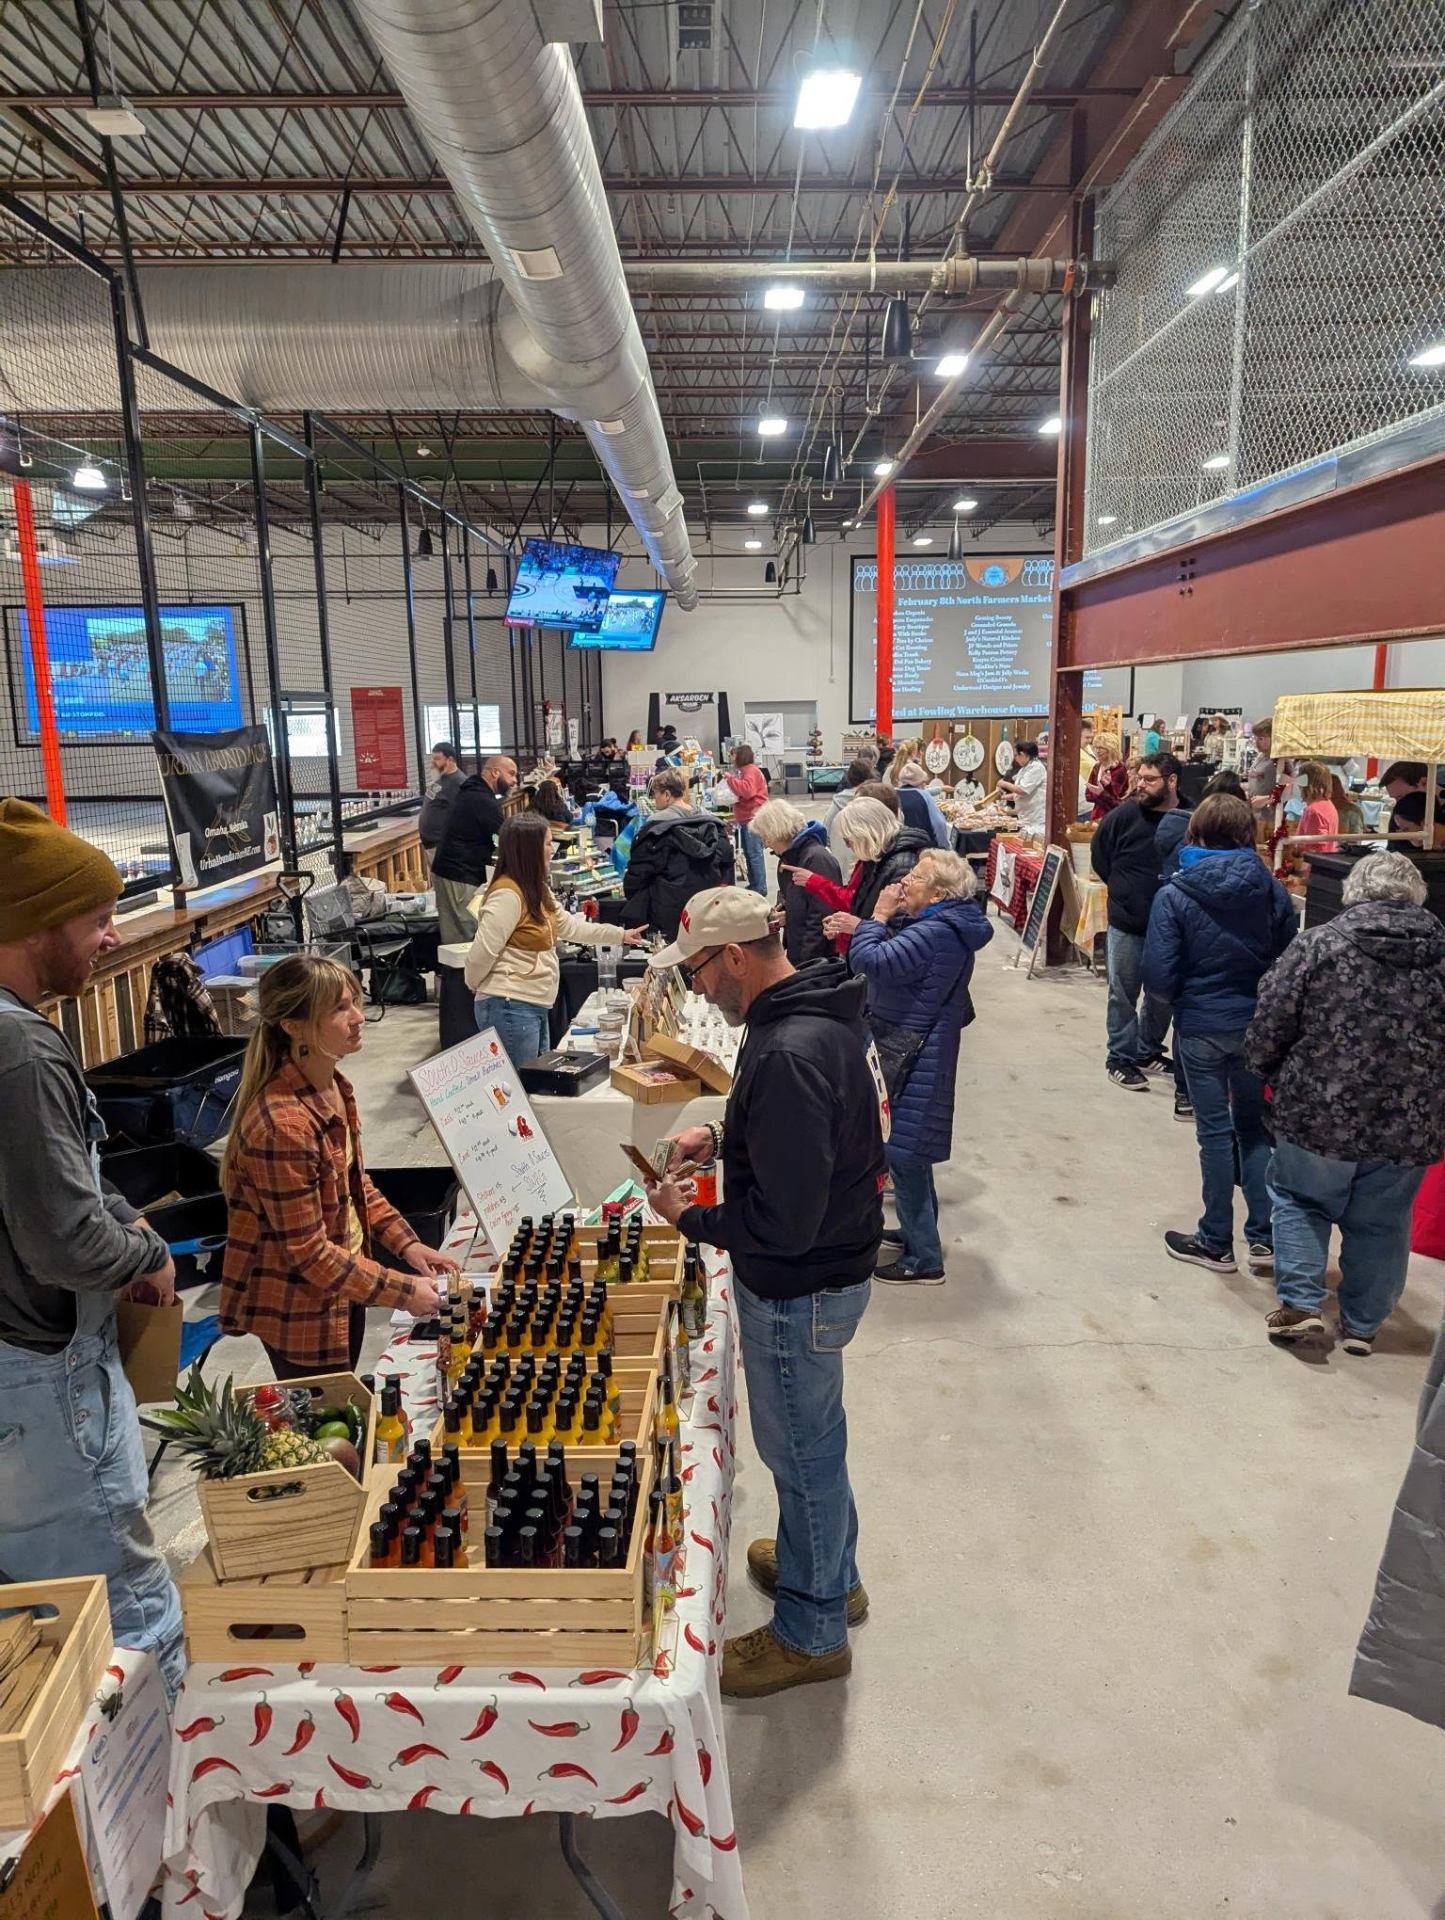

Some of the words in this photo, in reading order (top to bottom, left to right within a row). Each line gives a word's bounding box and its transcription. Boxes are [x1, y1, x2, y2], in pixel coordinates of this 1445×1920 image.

[898, 598, 938, 607] February
[939, 597, 955, 605] 8th
[957, 596, 982, 604] North
[983, 595, 1020, 604] Farmers
[1020, 594, 1052, 603] Market
[907, 707, 918, 716] at
[919, 706, 956, 718] Fowling
[957, 704, 1009, 715] Warehouse
[1010, 703, 1033, 714] from
[417, 1062, 451, 1092] South
[458, 1046, 489, 1070] Sauces
